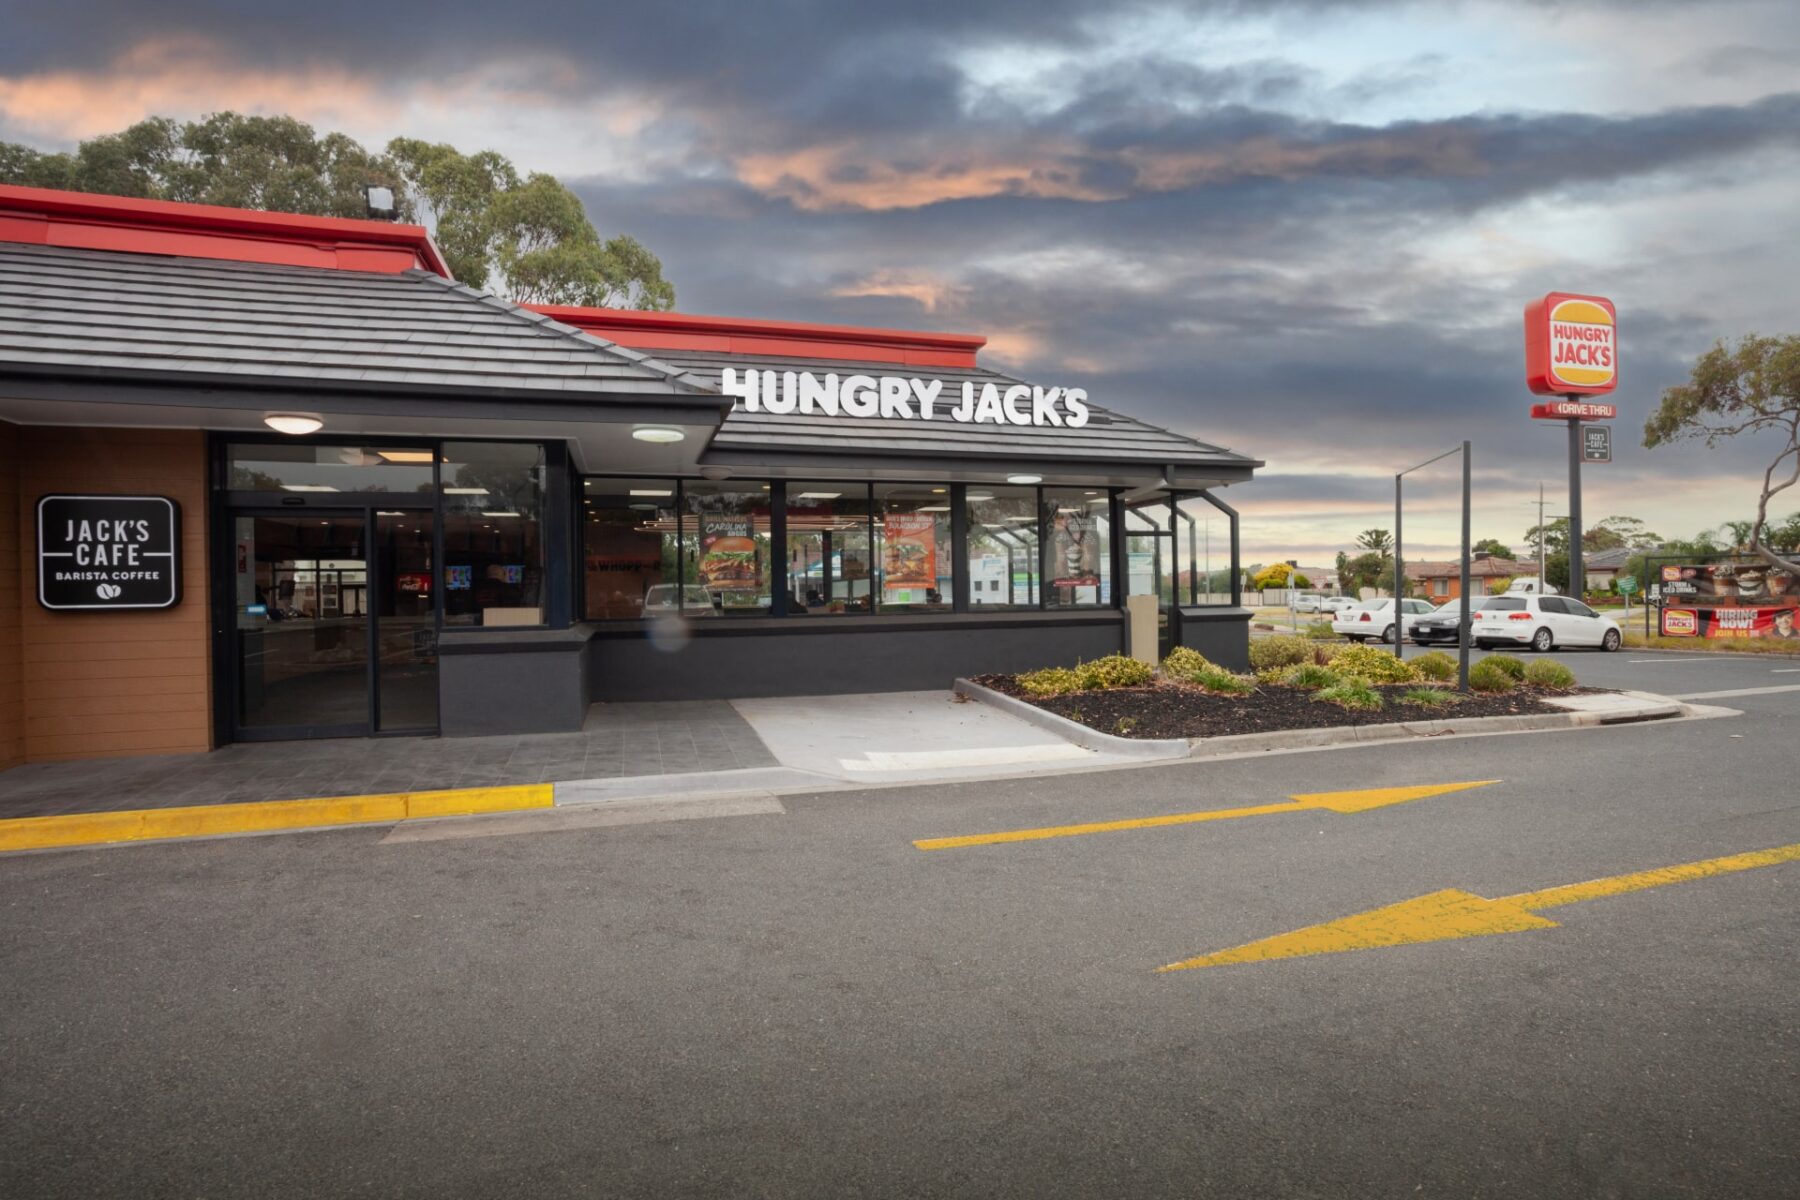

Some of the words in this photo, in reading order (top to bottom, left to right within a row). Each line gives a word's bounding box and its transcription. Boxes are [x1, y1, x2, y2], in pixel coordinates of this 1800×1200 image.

[1554, 324, 1611, 342] HUNGRY
[1554, 341, 1612, 367] JACK'S
[722, 367, 943, 420] HUNGRY
[951, 381, 1089, 428] JACK'S
[1562, 404, 1588, 415] DRIVE
[1590, 405, 1612, 416] THRU
[65, 519, 150, 542] JACK'S
[76, 544, 140, 566] CAFE
[56, 572, 109, 580] BARISTA
[112, 571, 159, 580] COFFEE
[1715, 609, 1758, 619] HIRING
[1720, 619, 1754, 629] NOW!
